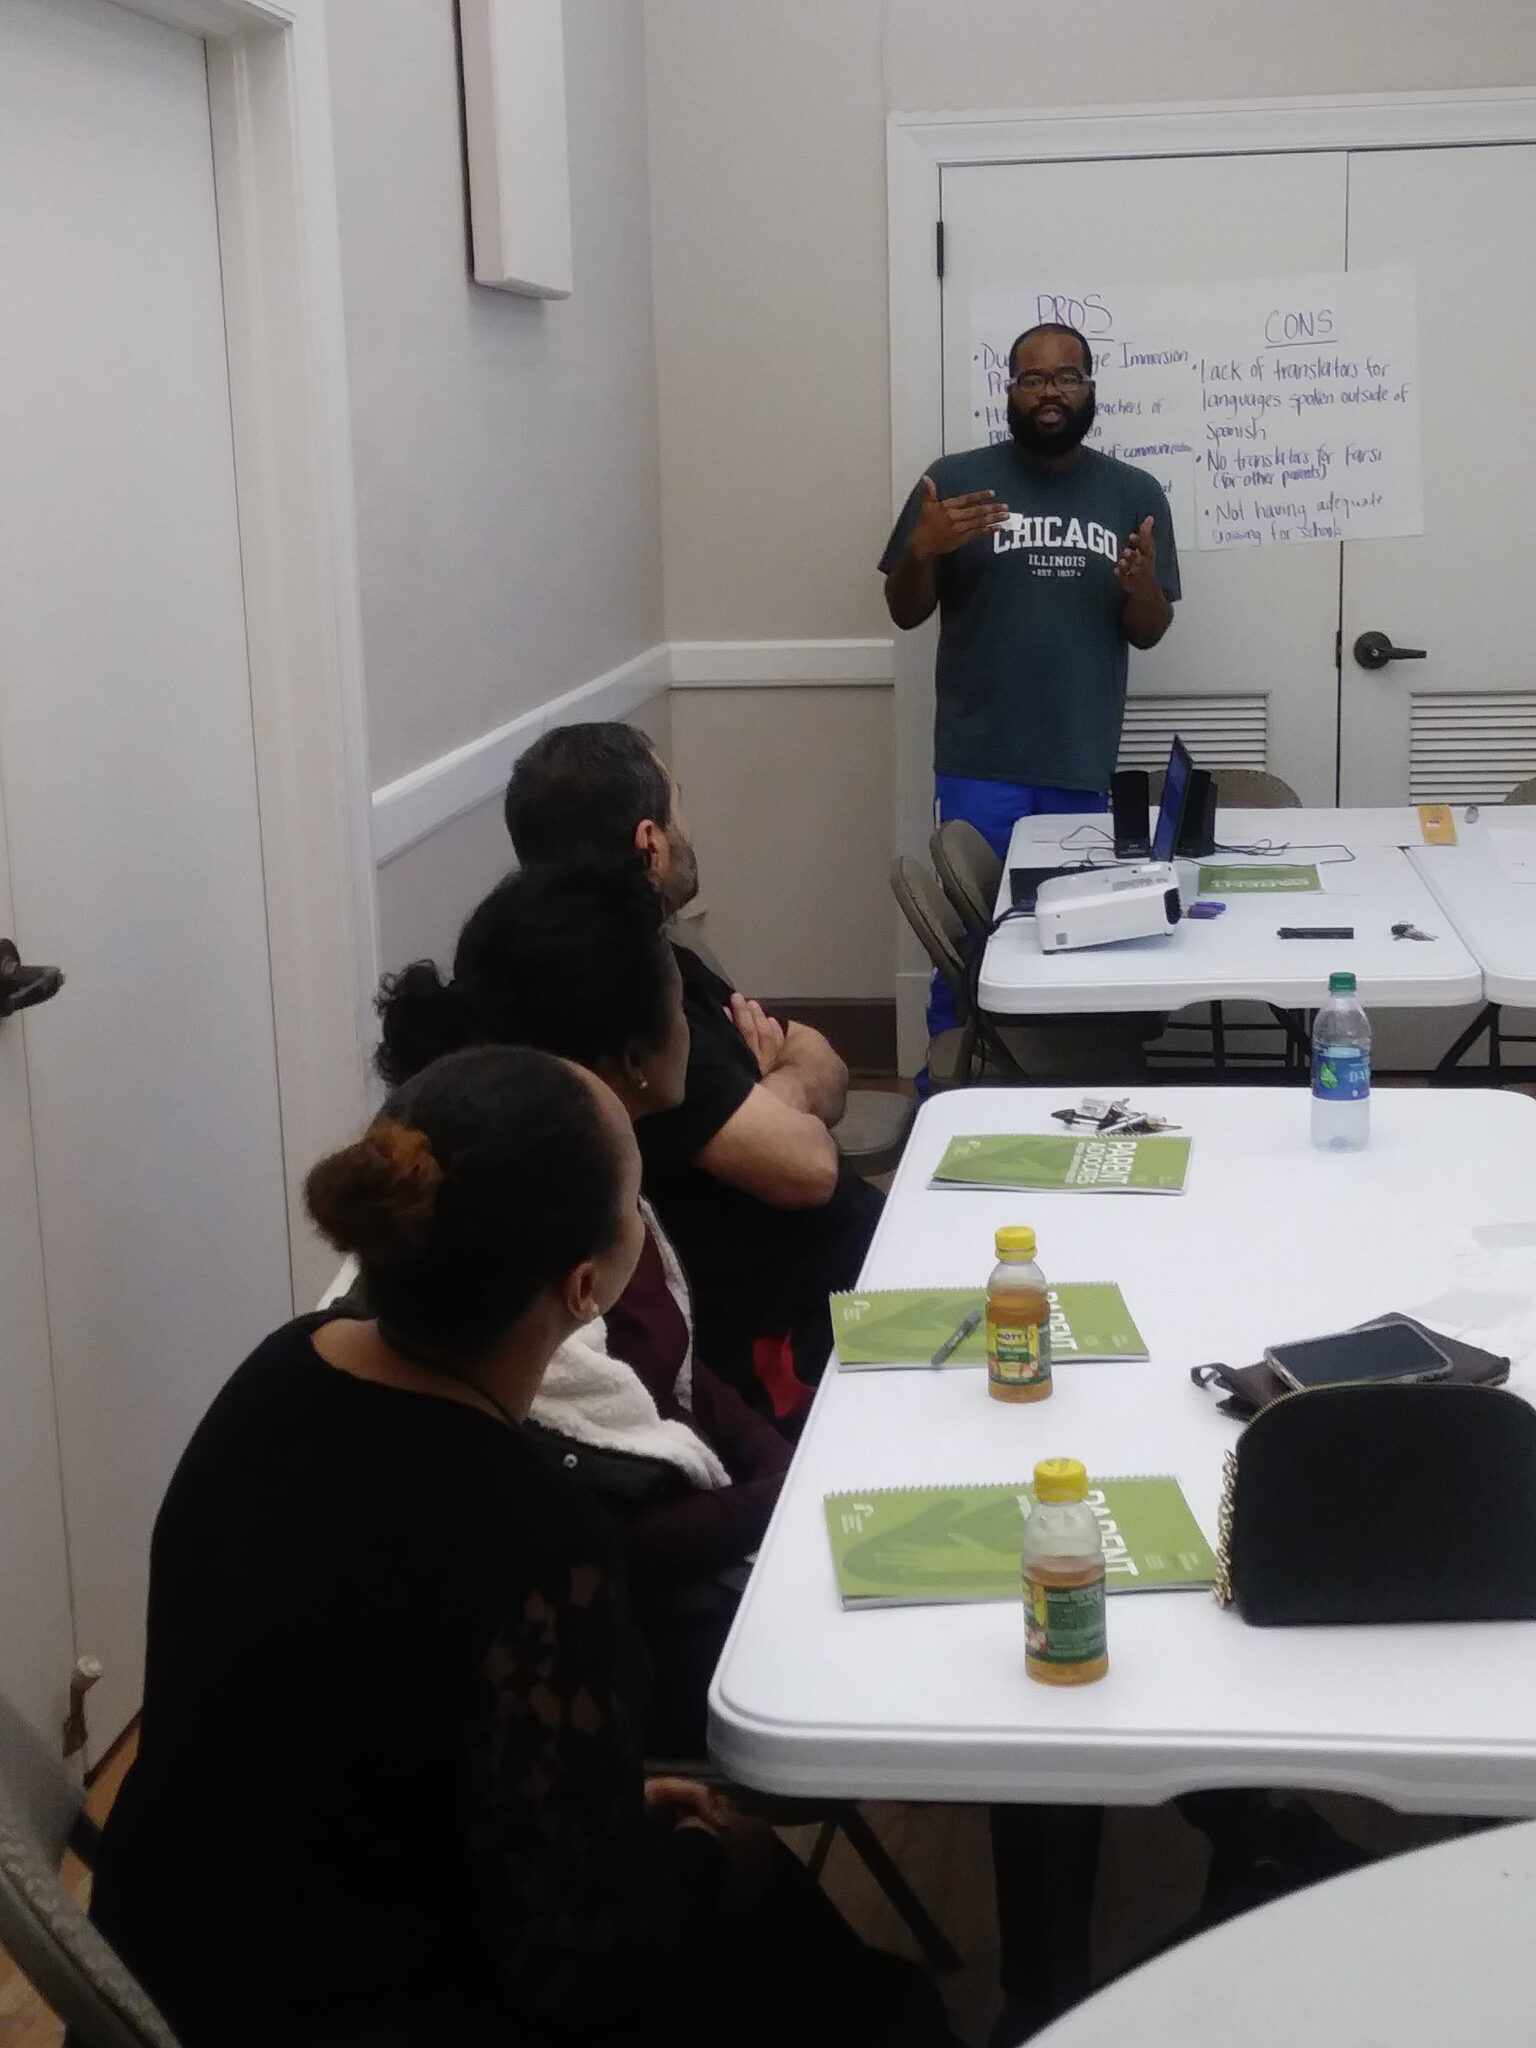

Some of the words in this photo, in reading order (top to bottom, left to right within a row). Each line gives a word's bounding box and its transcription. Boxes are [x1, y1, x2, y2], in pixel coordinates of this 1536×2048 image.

[1036, 294, 1113, 333] PROS
[1264, 309, 1333, 343] CONS
[1118, 341, 1189, 369] Immersion
[1250, 355, 1264, 382] of
[1366, 356, 1393, 378] for
[1202, 387, 1283, 416] languages
[1289, 387, 1335, 417] spoken
[1341, 384, 1389, 404] outside
[1394, 382, 1411, 403] of
[1205, 416, 1267, 447] Spanish
[1206, 448, 1228, 471] No
[1316, 442, 1336, 467] for
[1345, 442, 1383, 467] Farsi
[1243, 469, 1274, 487] other
[1215, 498, 1245, 525] Not
[1254, 498, 1307, 528] having
[1316, 491, 1384, 520] adequate
[993, 516, 1118, 564] CHICAGO
[1270, 520, 1295, 542] for
[1028, 553, 1087, 568] ILLINOIS
[1098, 1141, 1138, 1185] PARENT
